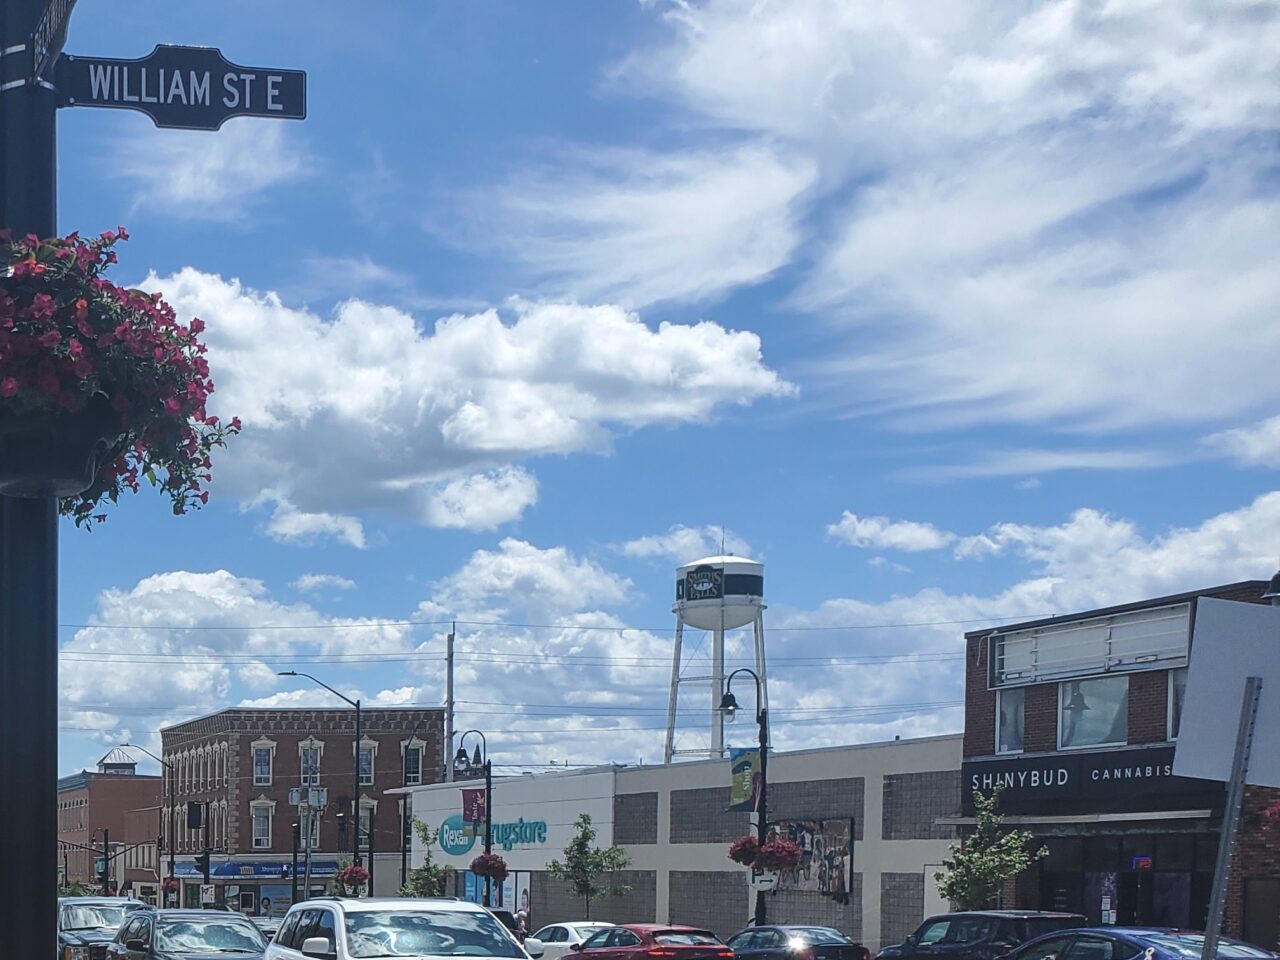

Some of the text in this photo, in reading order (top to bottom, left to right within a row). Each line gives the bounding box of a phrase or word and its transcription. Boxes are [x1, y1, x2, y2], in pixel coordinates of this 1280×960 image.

[89, 64, 284, 111] WILLIAM ST E
[743, 765, 752, 790] Shop
[972, 764, 1171, 790] SHINYBUD CANNABIS
[481, 816, 548, 851] rugstore
